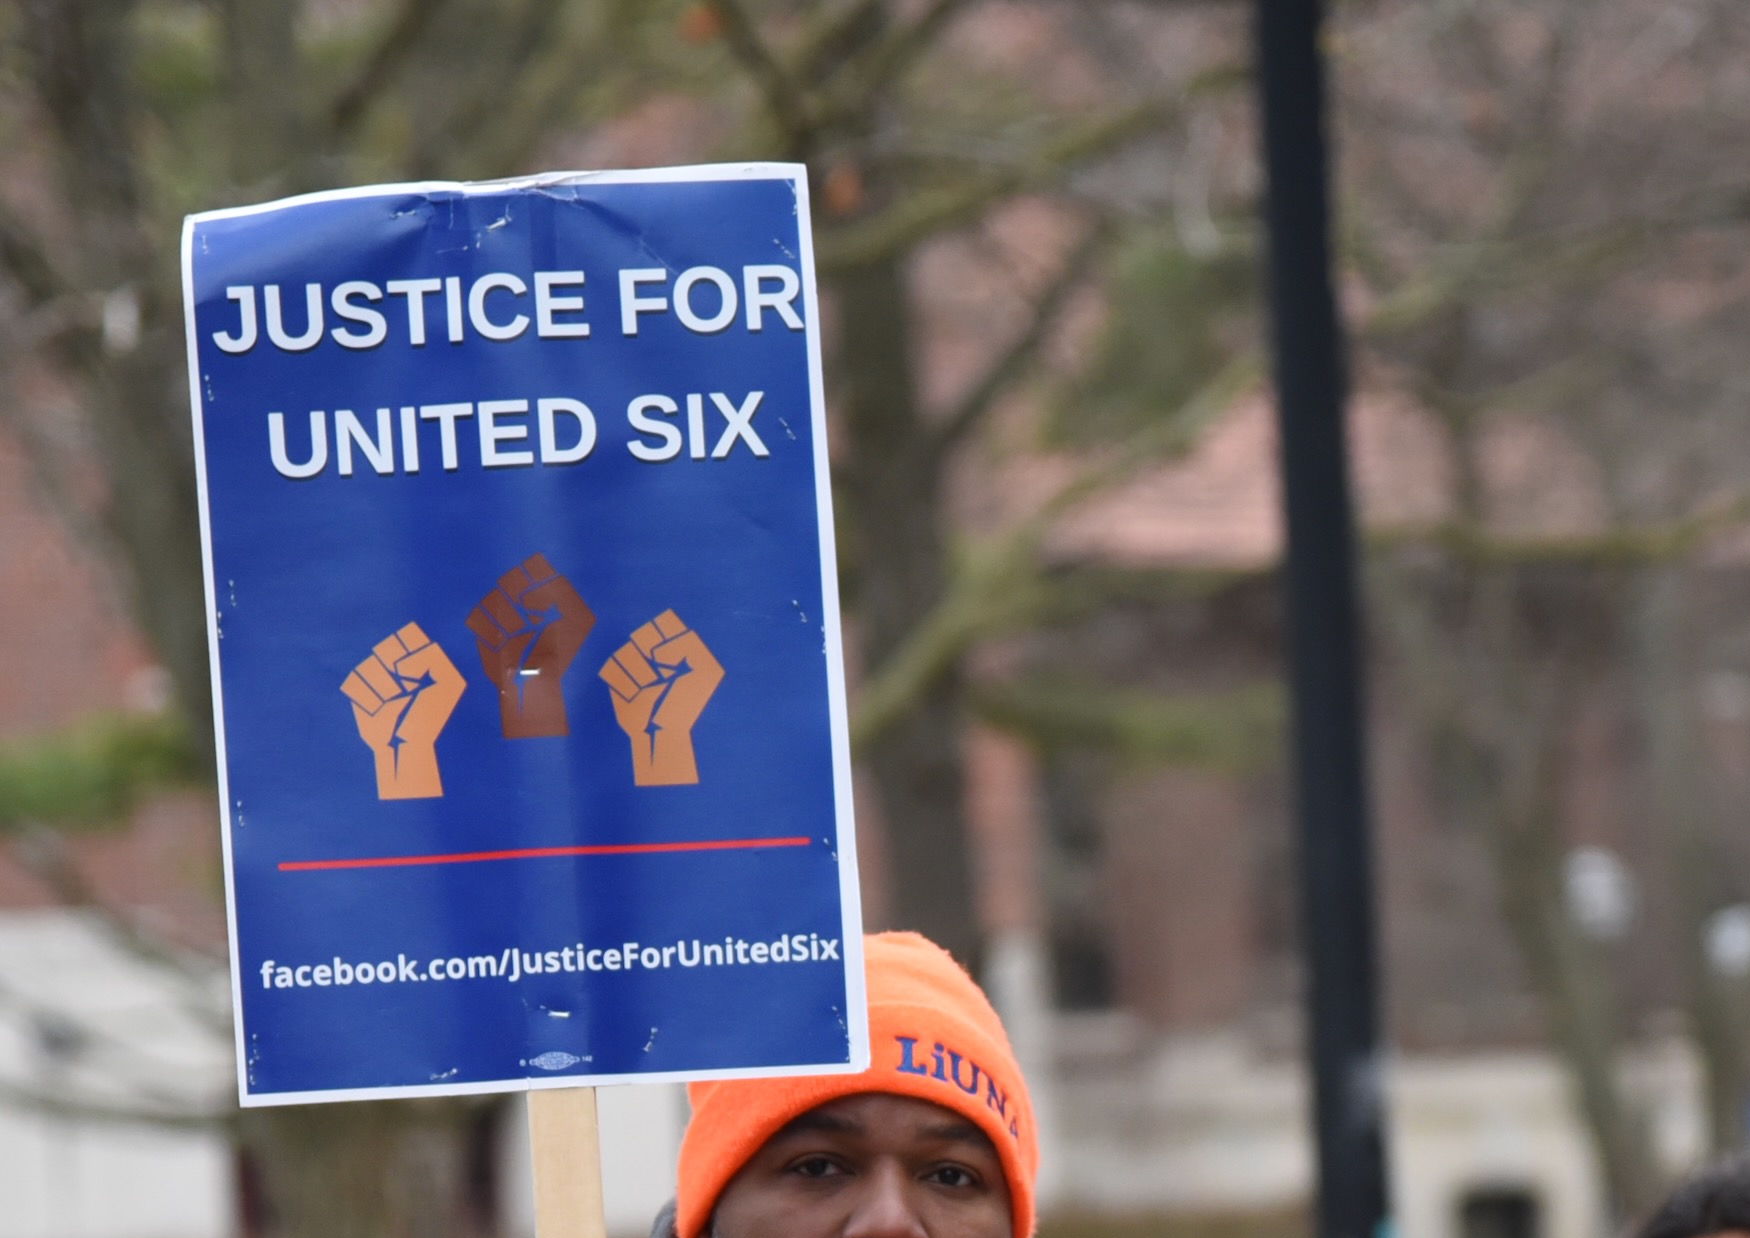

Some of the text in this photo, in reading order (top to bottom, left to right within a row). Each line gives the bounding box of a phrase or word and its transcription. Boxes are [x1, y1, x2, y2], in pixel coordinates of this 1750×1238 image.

[211, 264, 804, 354] JUSTICE FOR
[267, 391, 770, 479] UNITED SIX
[260, 933, 840, 990] facebook.com/JusticeForUnitedSix
